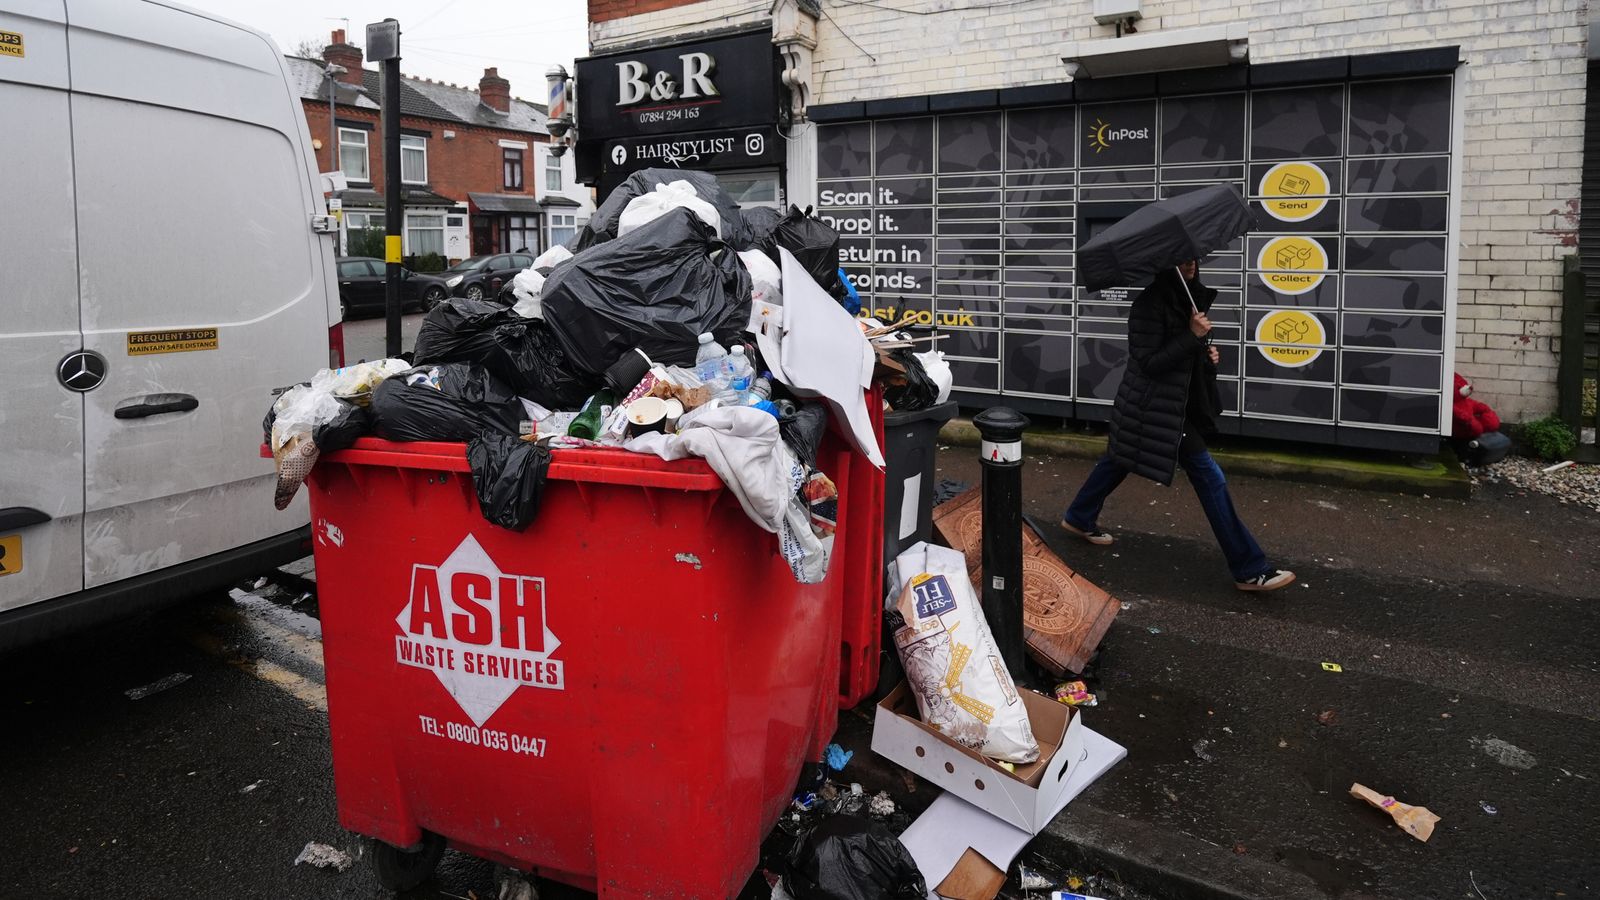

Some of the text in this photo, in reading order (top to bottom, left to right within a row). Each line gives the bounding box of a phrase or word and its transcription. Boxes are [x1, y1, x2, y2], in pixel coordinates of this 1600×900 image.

[615, 52, 720, 106] B&R
[640, 108, 700, 123] 07884 294 163
[1109, 128, 1148, 140] InPost
[636, 138, 734, 161] HAIRSTYLIST
[820, 187, 899, 206] Scan it.
[820, 214, 899, 234] Drop it.
[838, 245, 921, 262] eturn in
[847, 272, 921, 288] conds.
[1272, 275, 1311, 283] Collect
[131, 331, 215, 342] FREQUENT STOPS
[1271, 347, 1309, 355] Return
[1026, 560, 1068, 589] ELICIOUS
[410, 566, 545, 652] ASH
[1023, 584, 1074, 619] ZZA
[399, 639, 558, 685] WASTE SERVICES
[419, 715, 546, 758] TEL: 0800 035 0447
